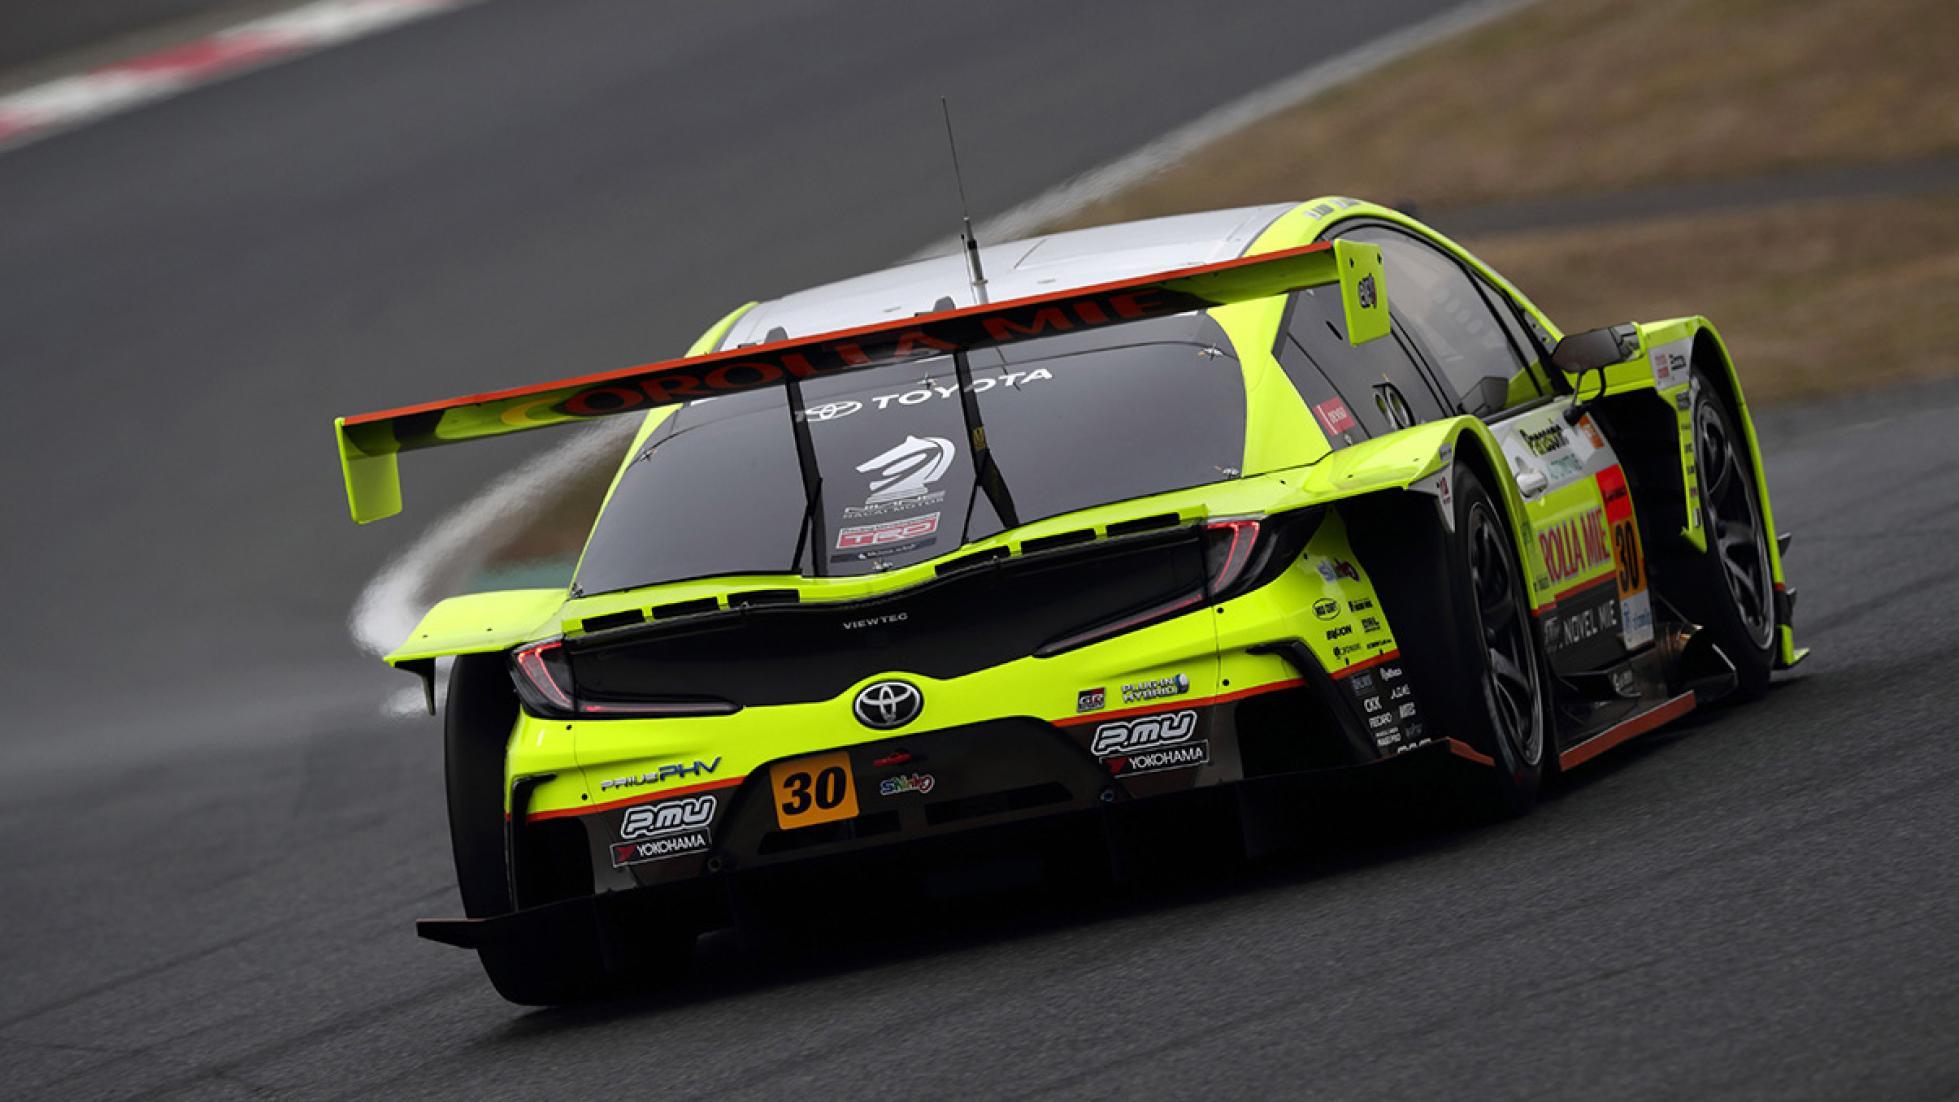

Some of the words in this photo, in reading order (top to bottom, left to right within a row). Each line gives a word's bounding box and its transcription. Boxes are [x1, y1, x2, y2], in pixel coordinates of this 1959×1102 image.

[872, 368, 1053, 409] TOYOTA
[844, 519, 932, 546] TRD
[1615, 521, 1640, 592] 30
[1128, 746, 1204, 770] YOKOHAMA
[781, 766, 847, 816] 30
[636, 833, 707, 858] YOKOHAMA
